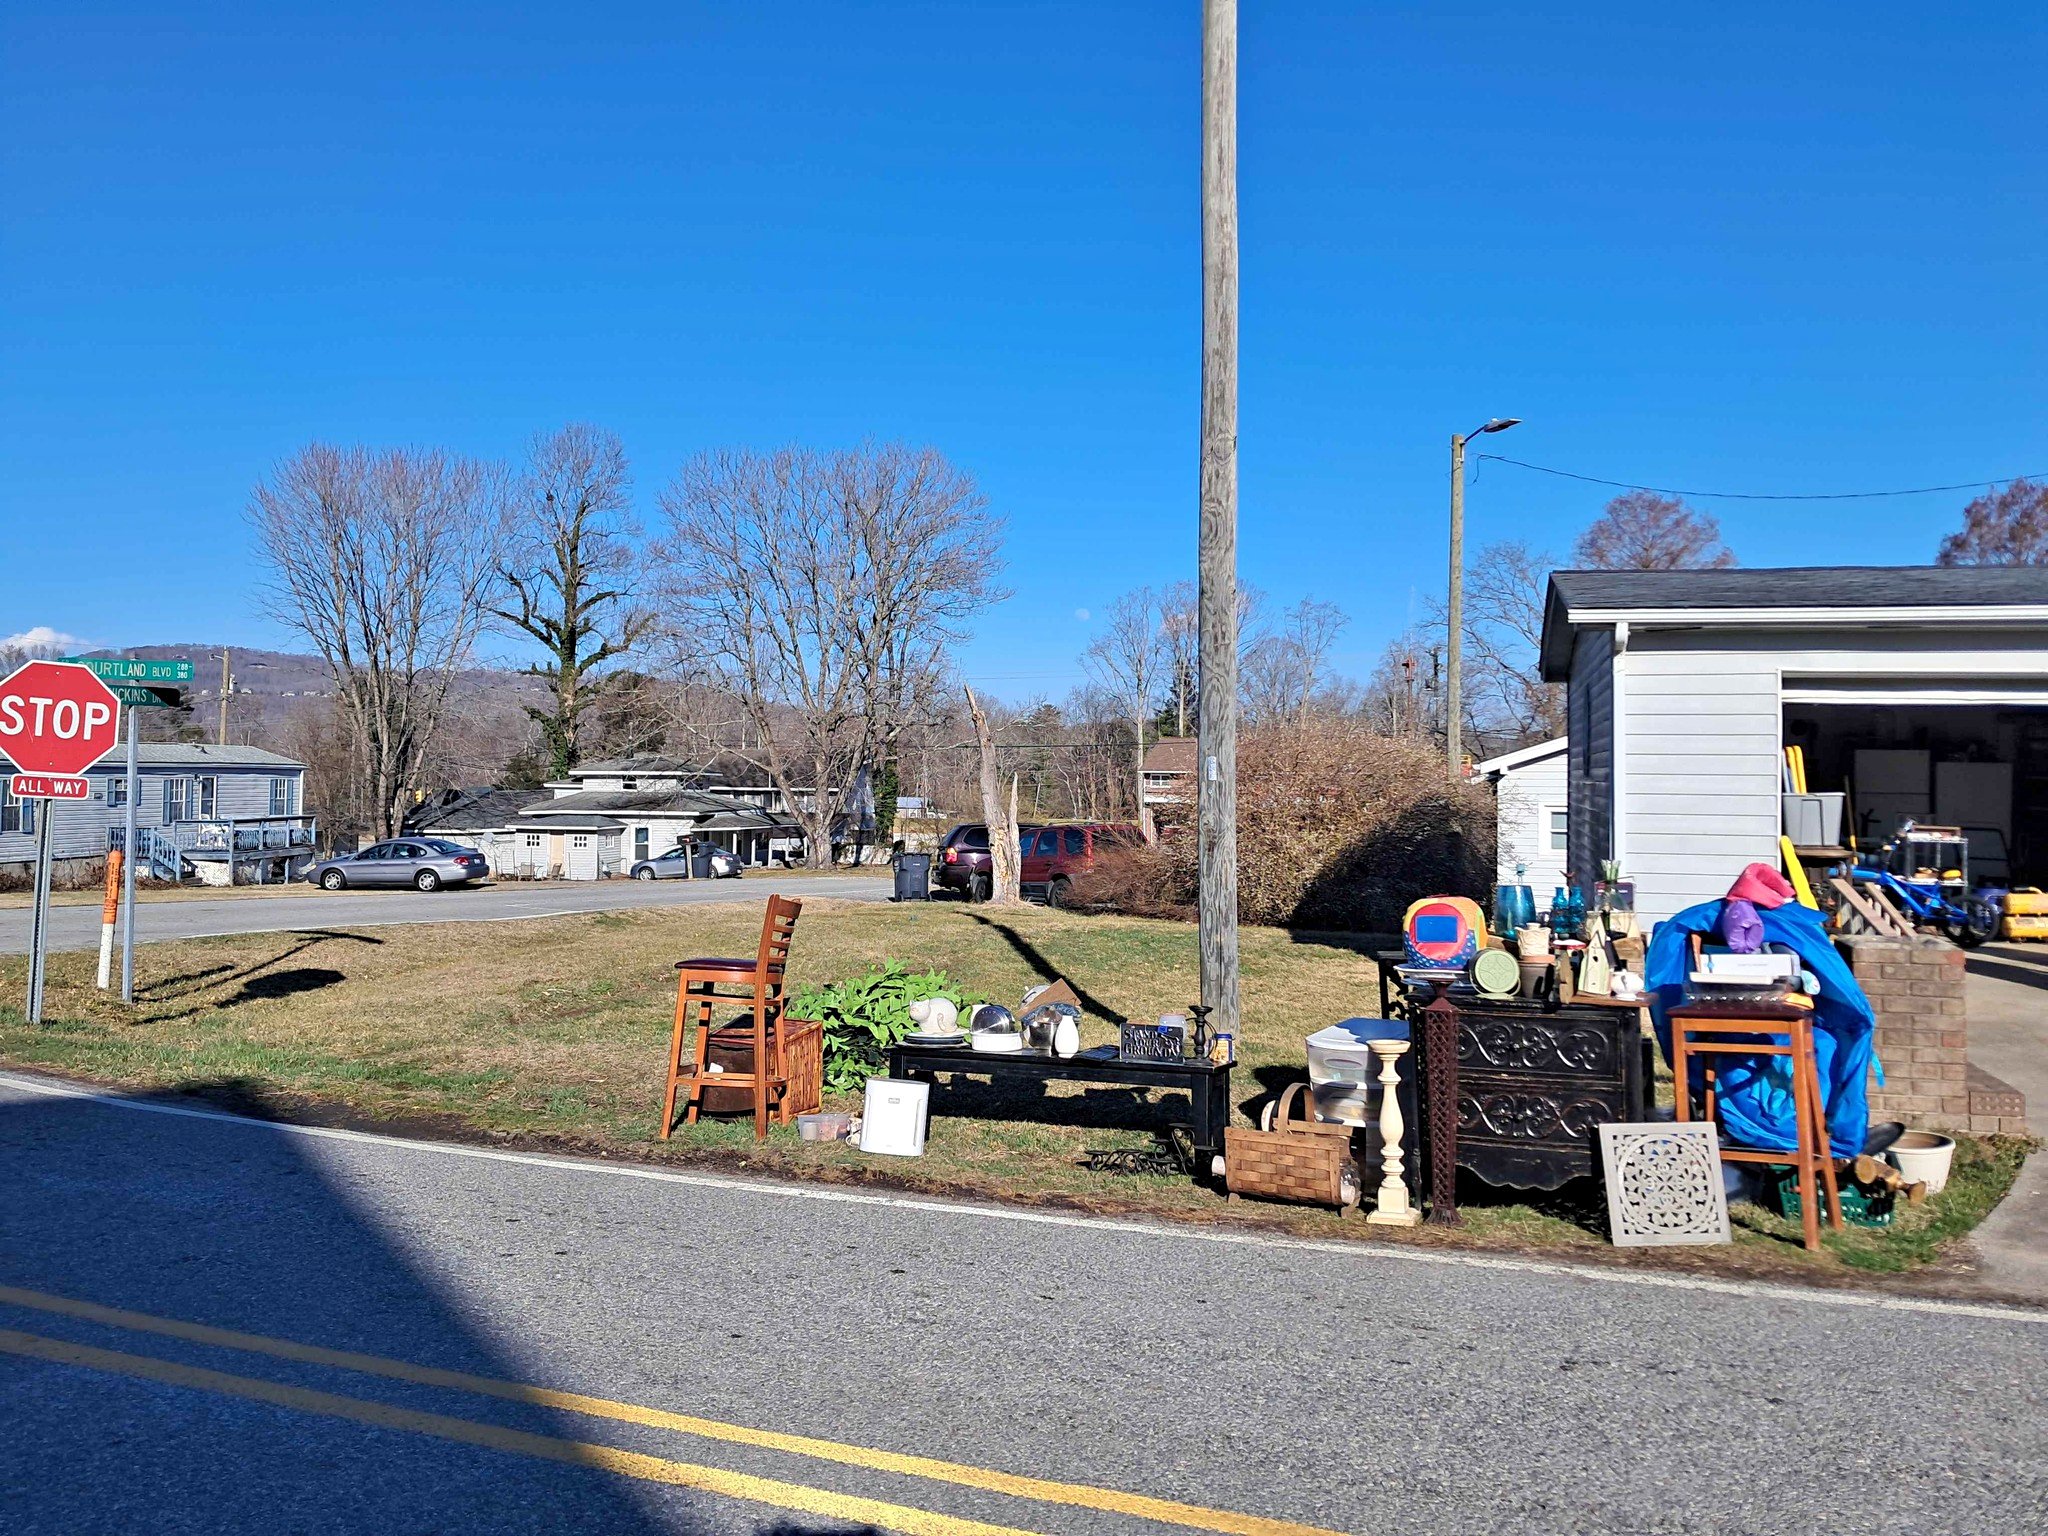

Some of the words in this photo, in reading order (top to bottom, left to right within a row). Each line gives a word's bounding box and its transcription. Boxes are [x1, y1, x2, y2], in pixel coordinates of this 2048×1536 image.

[78, 661, 146, 677] OURTLAND
[152, 667, 172, 677] BLVD
[0, 695, 111, 740] STOP
[18, 779, 45, 793] ALL
[53, 781, 82, 795] WAY
[1124, 1042, 1171, 1057] GROUND
[1133, 1038, 1161, 1047] YOUR
